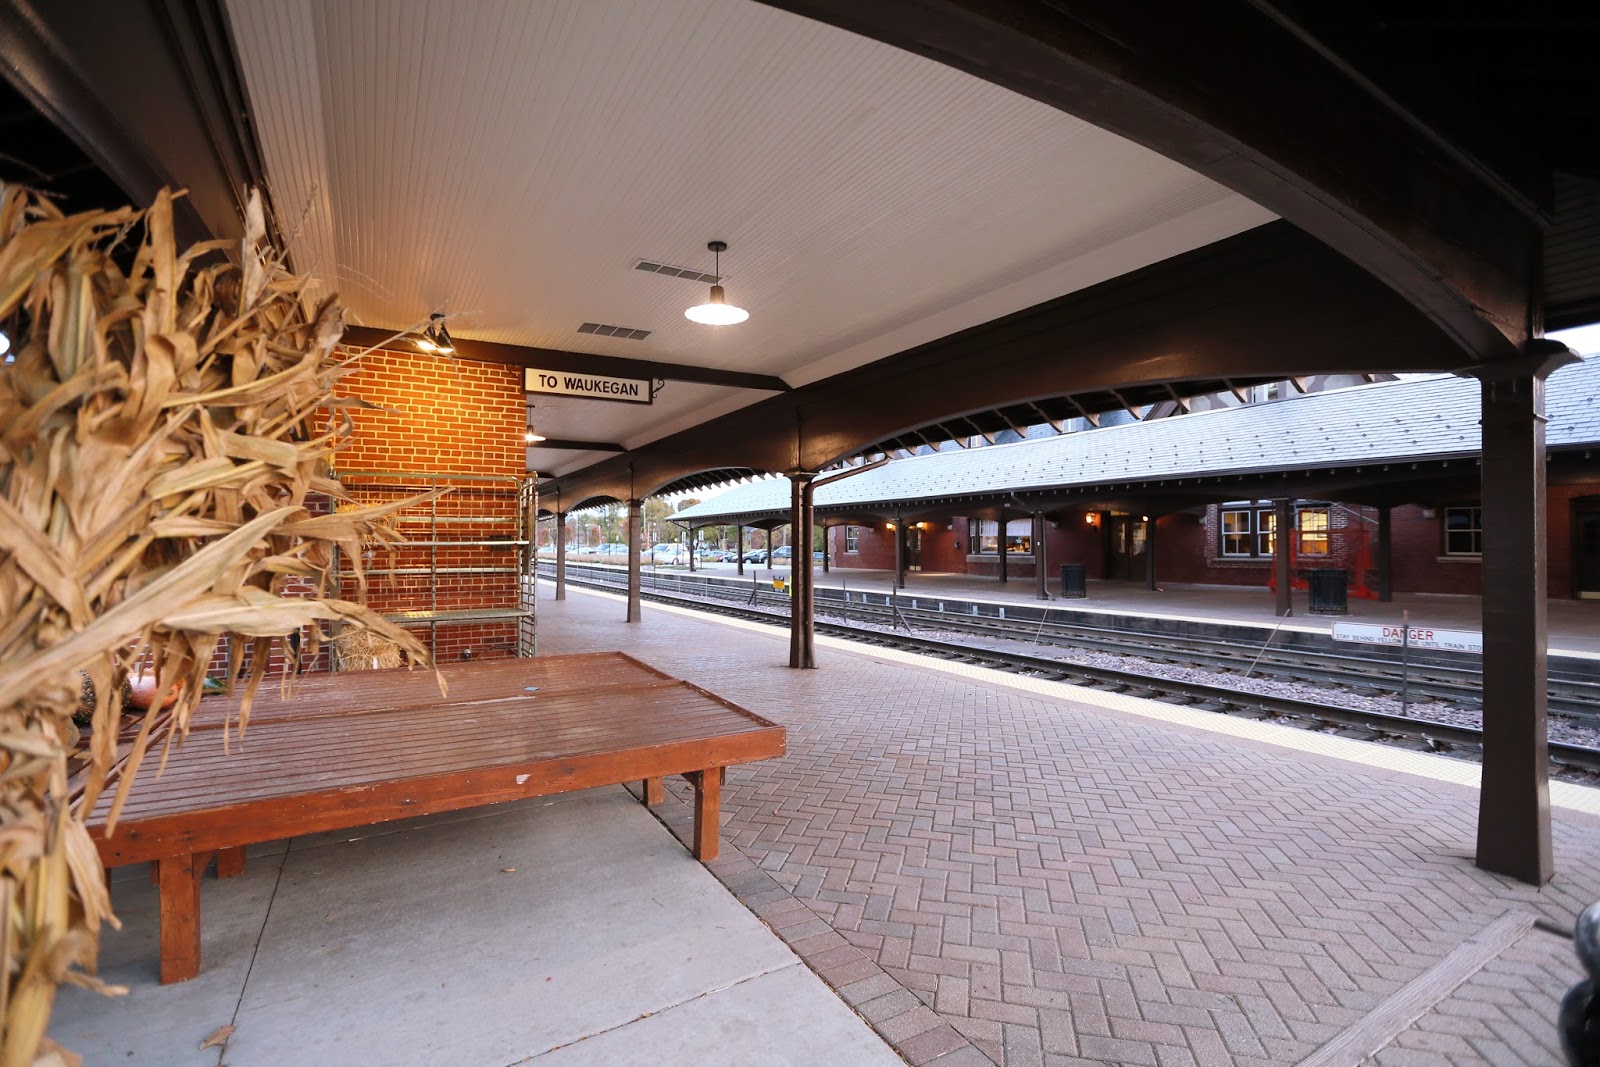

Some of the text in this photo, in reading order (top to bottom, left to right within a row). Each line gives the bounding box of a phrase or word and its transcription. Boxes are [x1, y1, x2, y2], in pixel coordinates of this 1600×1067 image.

[539, 374, 639, 396] TO WAUKEGAN
[1382, 627, 1434, 641] DANGER
[1377, 636, 1402, 644] YELLOW
[1444, 642, 1465, 650] TRAIN
